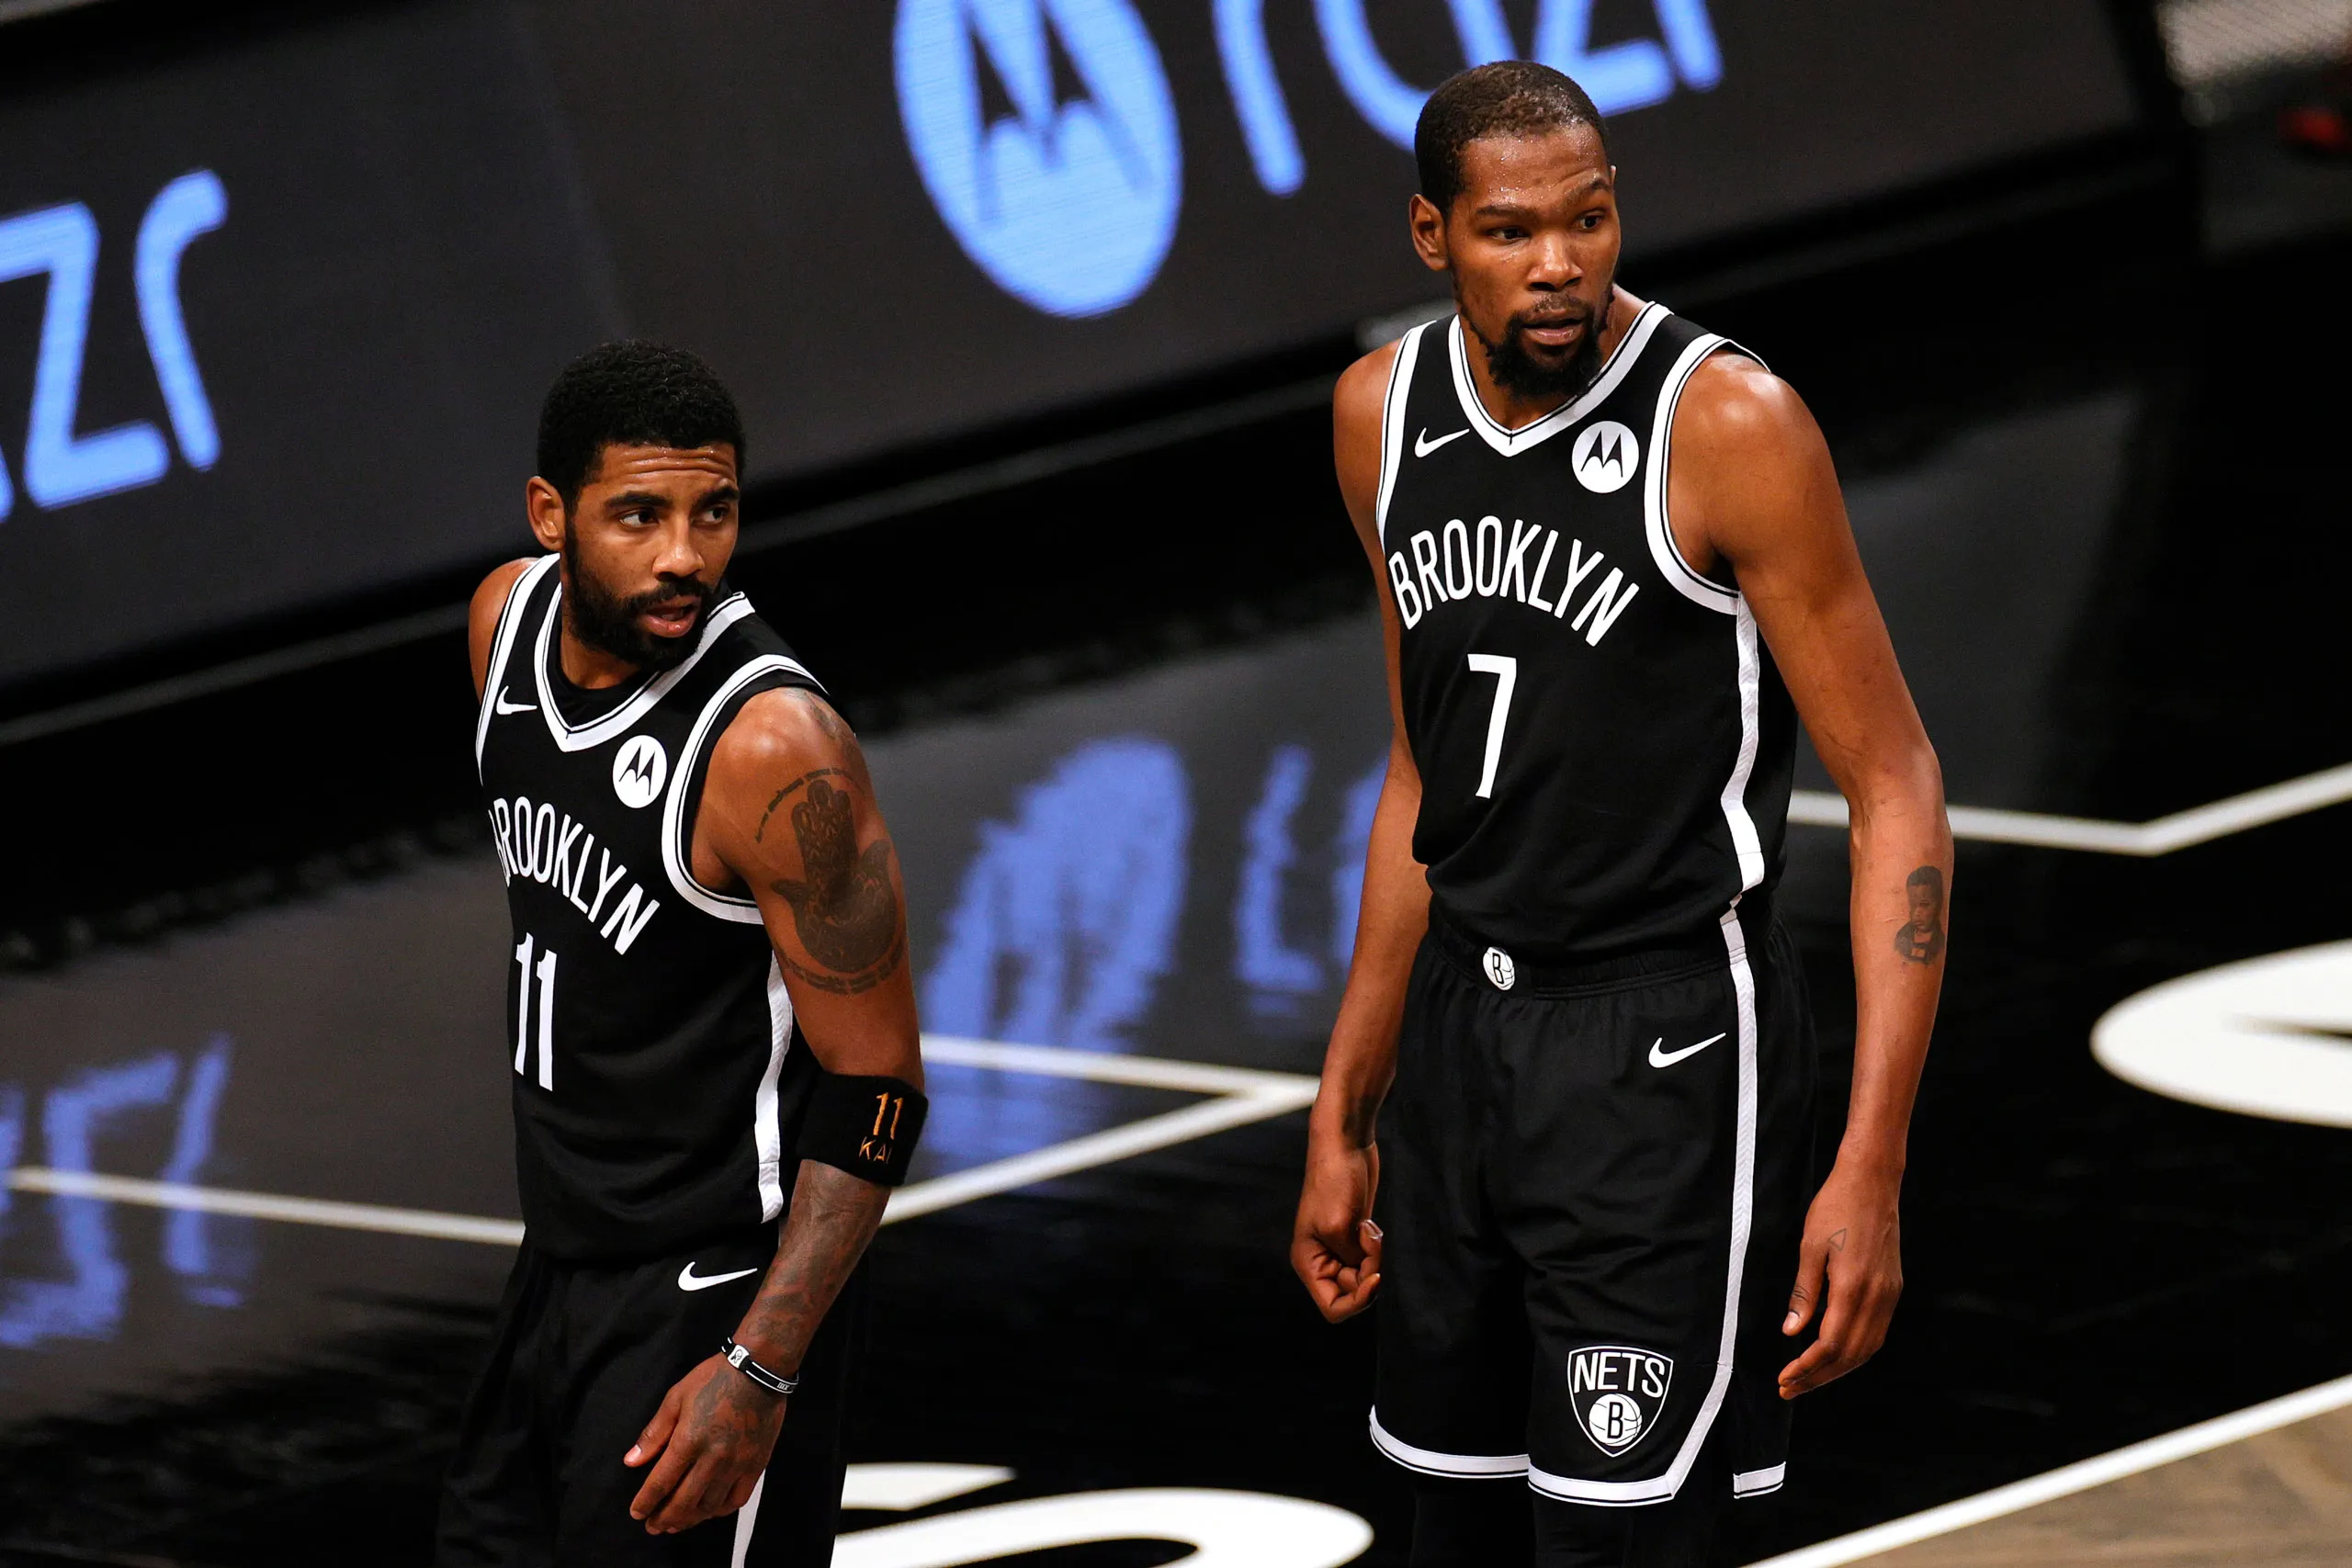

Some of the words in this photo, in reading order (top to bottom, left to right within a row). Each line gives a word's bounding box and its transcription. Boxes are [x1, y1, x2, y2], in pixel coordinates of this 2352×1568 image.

[1388, 515, 1640, 647] BROOKLYN
[1467, 653, 1517, 799] 7
[514, 931, 558, 1092] 11
[873, 1092, 904, 1140] 11
[858, 1135, 893, 1165] KAI
[1574, 1351, 1666, 1398] NETS
[1607, 1401, 1623, 1439] B
